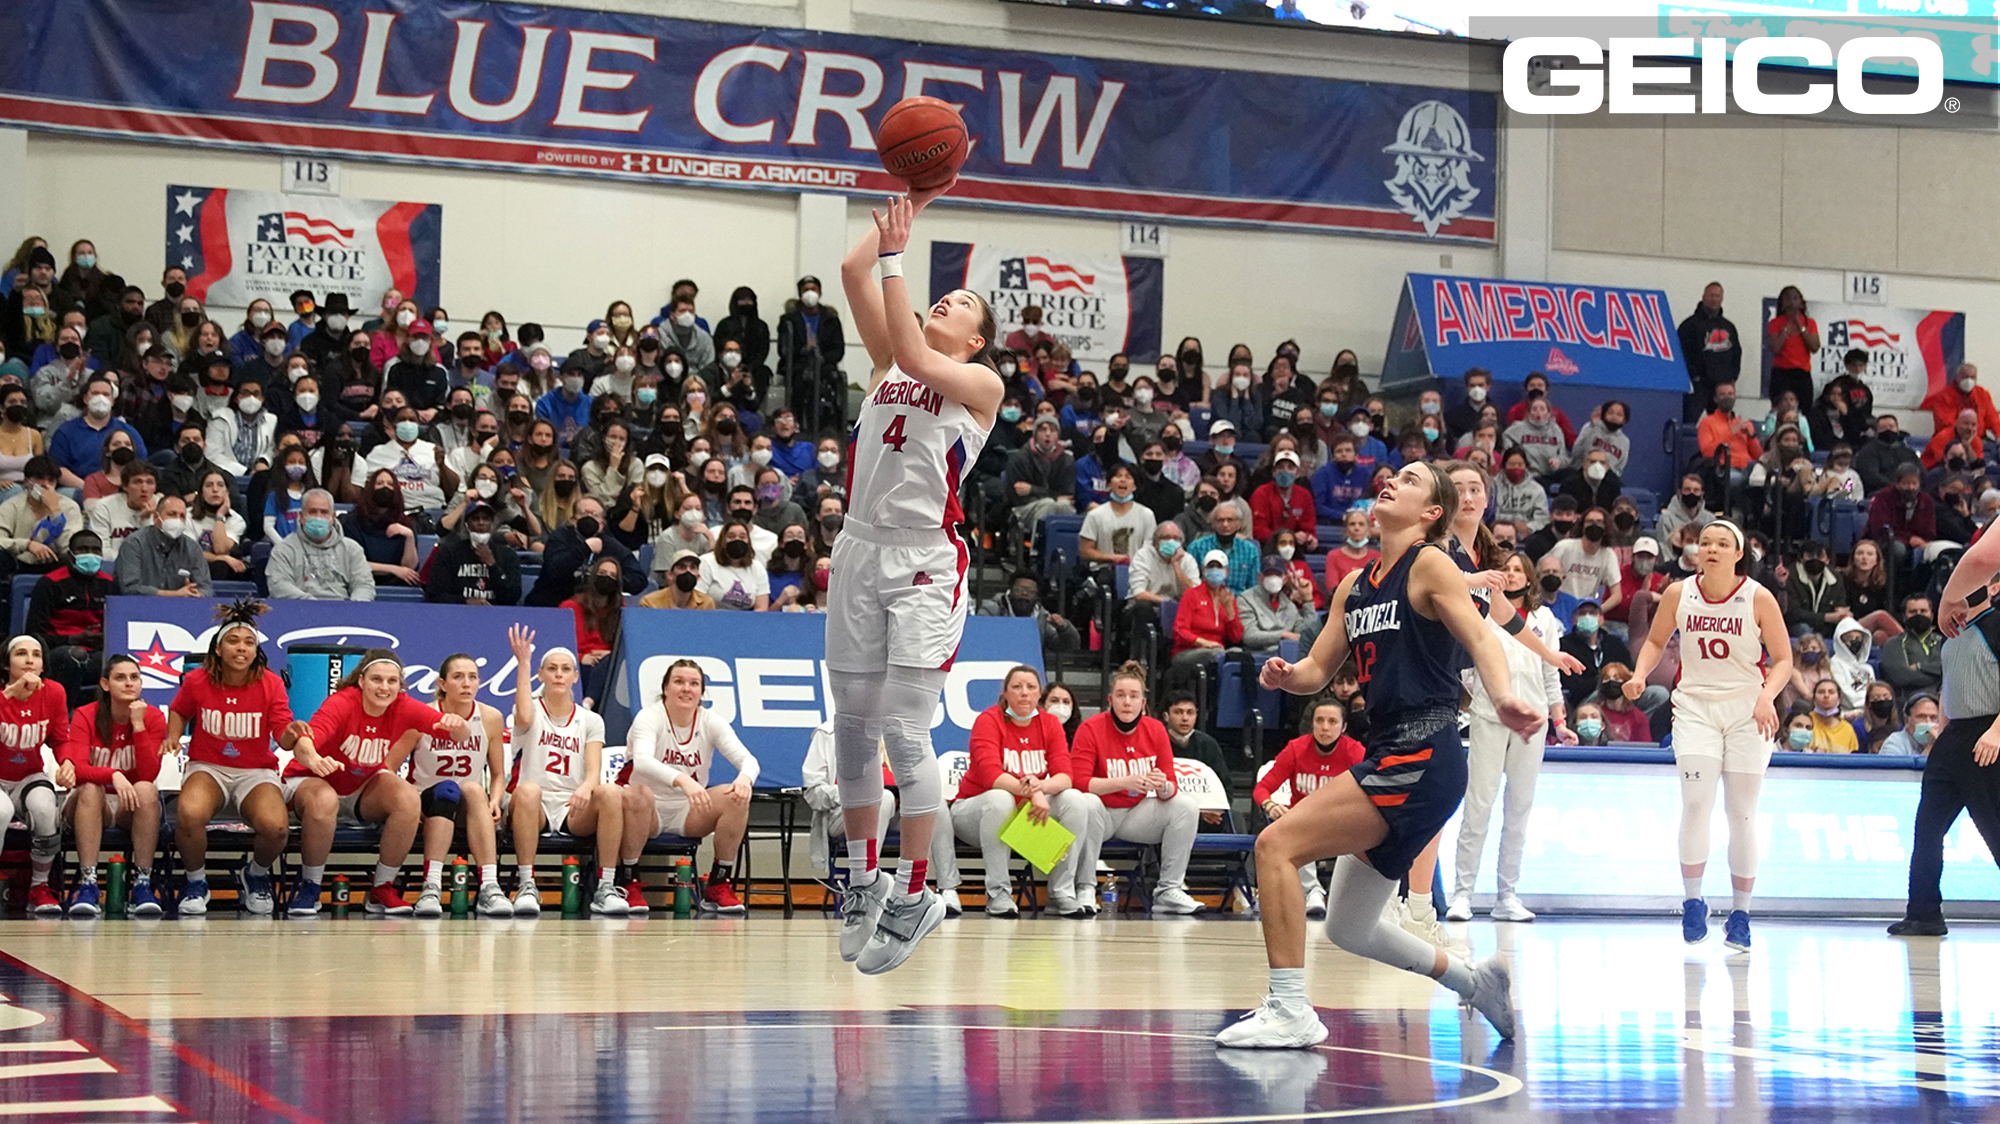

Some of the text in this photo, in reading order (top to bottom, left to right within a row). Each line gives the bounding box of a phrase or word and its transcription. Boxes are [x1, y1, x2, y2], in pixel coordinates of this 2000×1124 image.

[232, 0, 657, 133] BLUE
[890, 140, 950, 170] Wilson
[296, 161, 328, 182] 113
[537, 151, 859, 187] POWERED BY UNDER ARMOUR
[1130, 224, 1160, 245] 114
[246, 242, 366, 265] PATRIOT
[246, 259, 365, 281] LEAGUE
[1853, 276, 1880, 295] 115
[989, 290, 1106, 313] PATRIOT
[992, 306, 1106, 331] EGUE
[1433, 278, 1675, 362] AMERICAN
[1821, 346, 1909, 366] PAIOT
[1821, 360, 1909, 380] LEGUE
[872, 380, 945, 417] AMERICAN
[882, 414, 908, 454] 4
[1345, 600, 1401, 642] CKNELL
[1685, 614, 1743, 637] AMERICAN
[1697, 637, 1730, 660] 10
[1355, 641, 1377, 684] 12
[638, 654, 1024, 736] GEO
[201, 707, 262, 738] NO QUIT
[110, 744, 137, 771] QUI
[435, 755, 472, 777] 23
[545, 751, 570, 776] 21
[1106, 758, 1127, 779] NO
[1178, 777, 1209, 786] RIOT
[1786, 813, 1906, 862] THE
[455, 872, 467, 885] G
[337, 889, 348, 902] G
